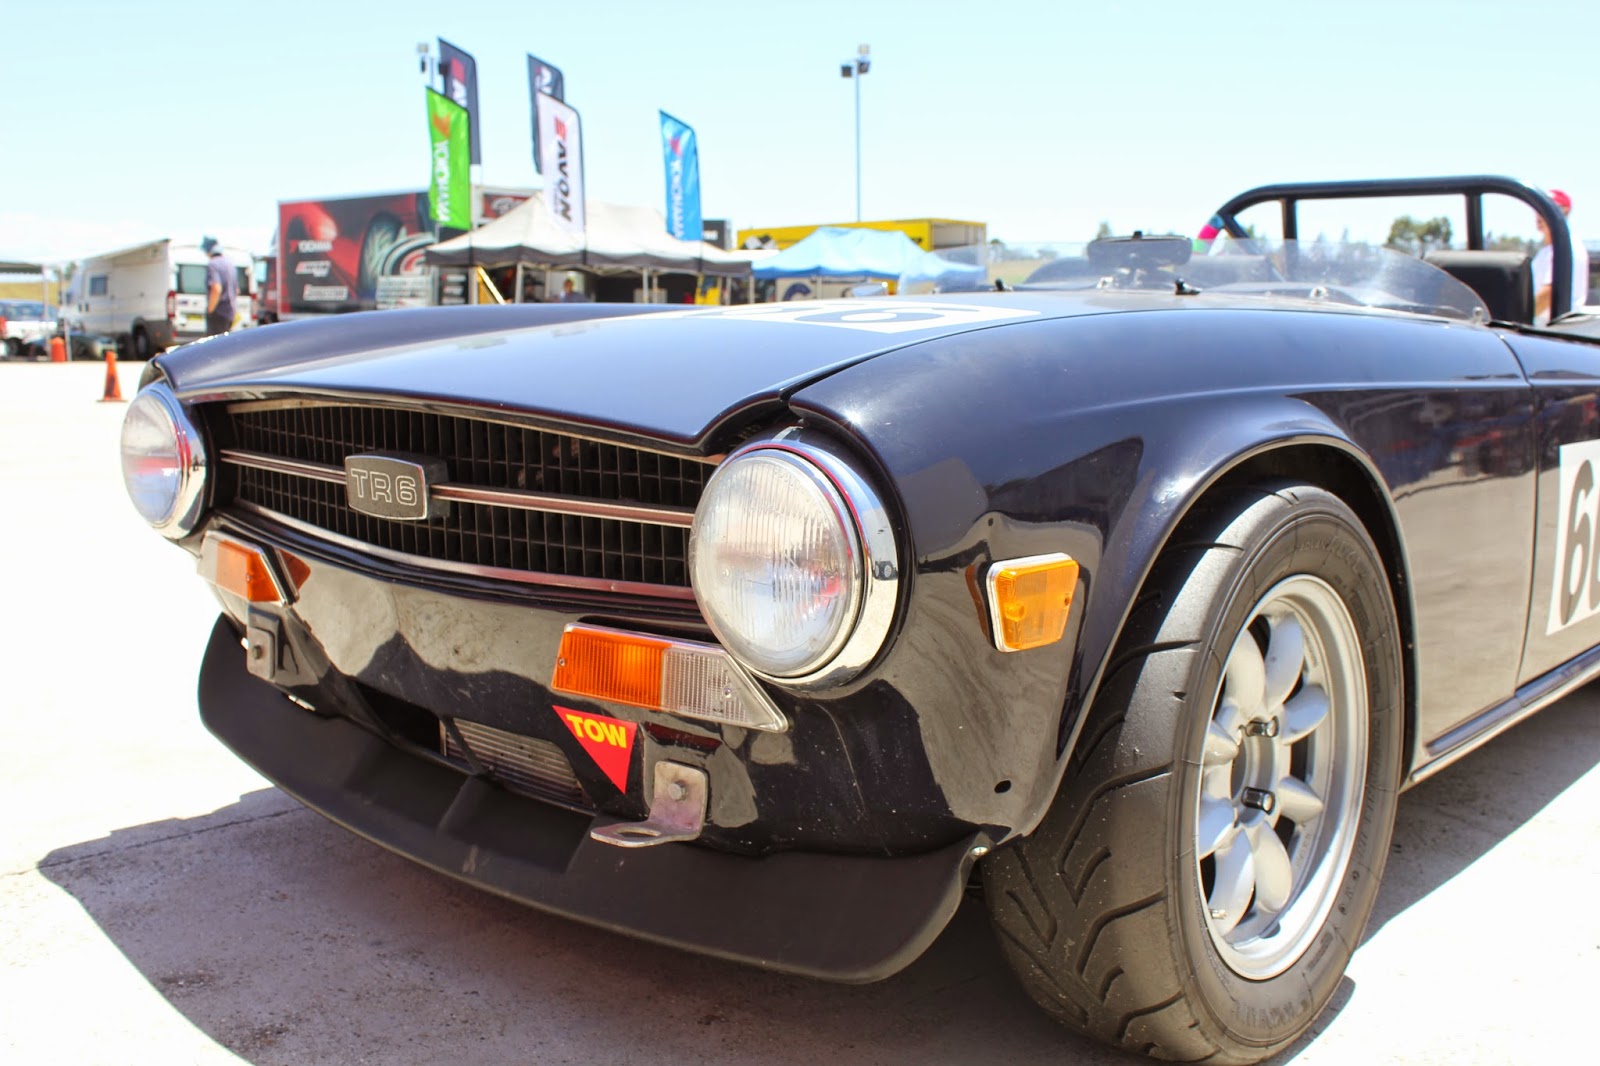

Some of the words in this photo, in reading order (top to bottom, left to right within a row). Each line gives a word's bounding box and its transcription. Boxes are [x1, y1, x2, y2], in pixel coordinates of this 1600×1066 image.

[557, 141, 573, 222] AVON
[350, 468, 418, 507] TR6
[565, 713, 627, 749] TOW
